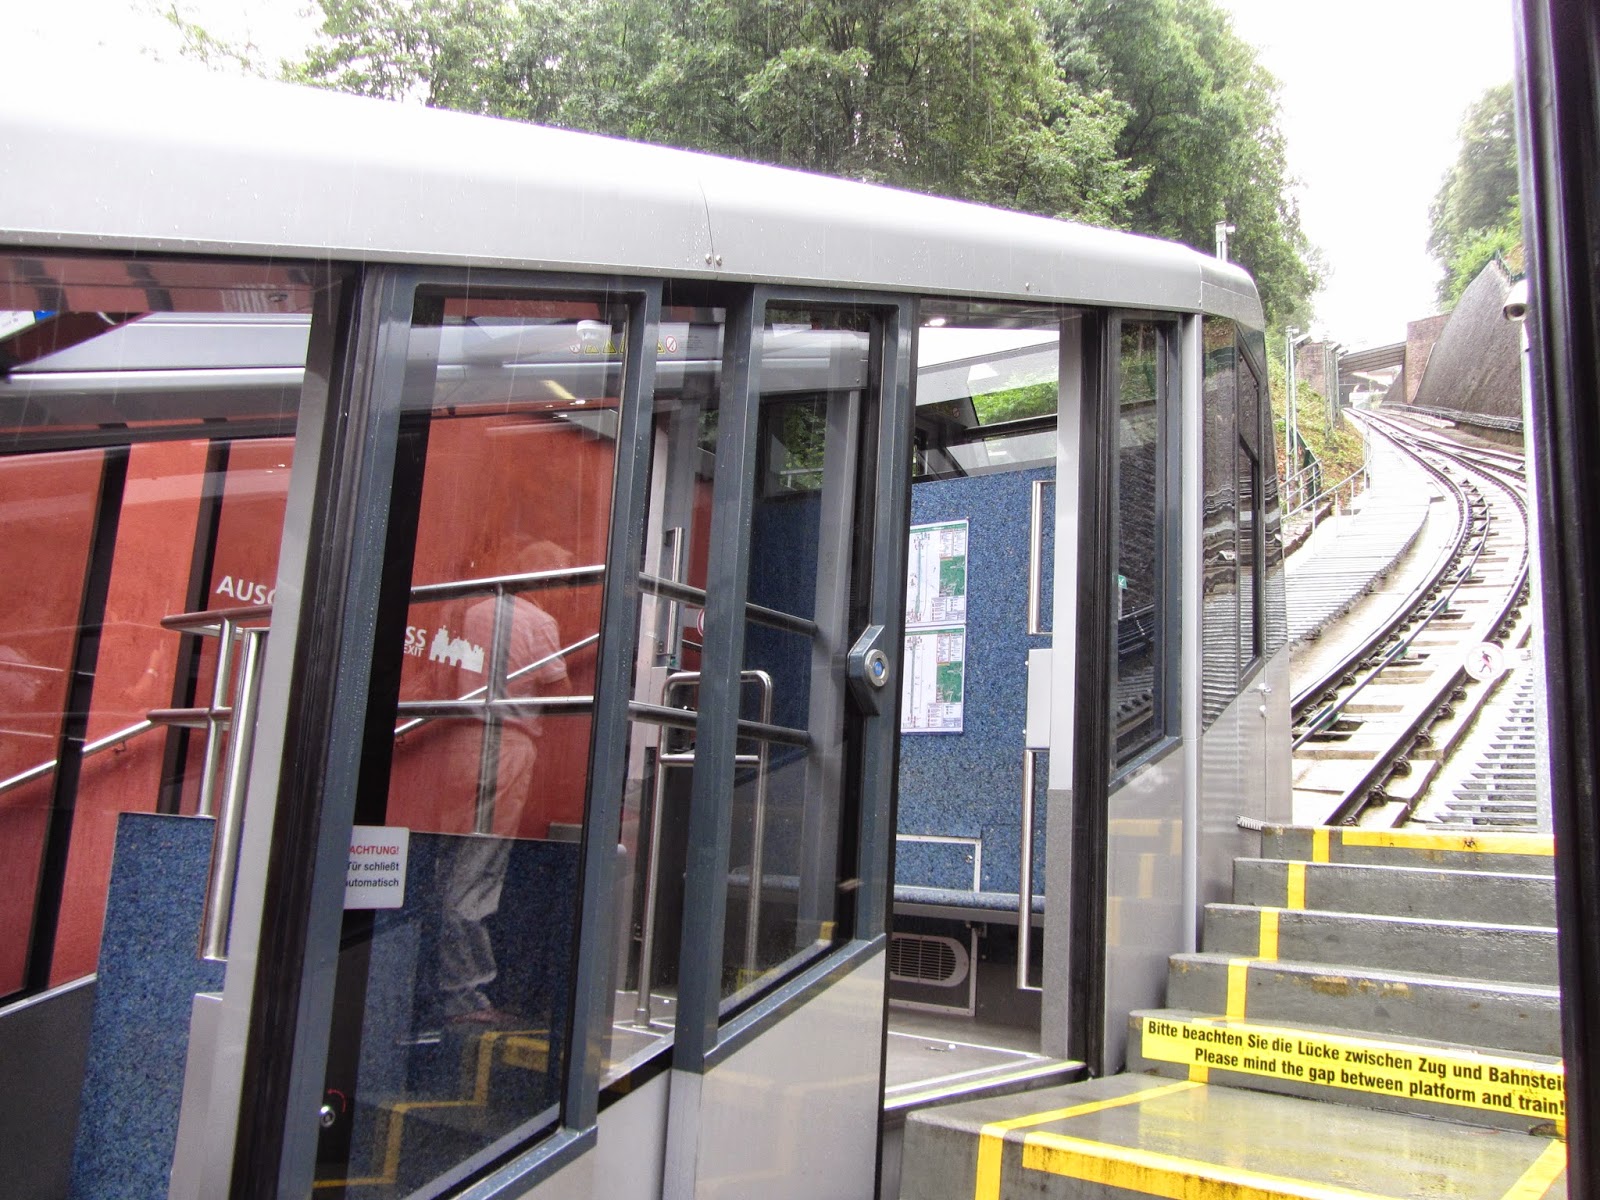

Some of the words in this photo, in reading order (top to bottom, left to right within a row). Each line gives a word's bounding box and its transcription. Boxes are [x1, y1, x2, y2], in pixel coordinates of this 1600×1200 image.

[404, 643, 424, 657] EXIT
[350, 845, 399, 855] ACHTUNG!
[363, 861, 399, 871] schließt
[1148, 1020, 1178, 1037] Bitte
[1182, 1025, 1243, 1047] beachten
[1247, 1034, 1268, 1050] Sie
[1272, 1038, 1292, 1053] die
[1298, 1040, 1339, 1060] Lücke
[1345, 1050, 1412, 1070] zwischen
[1418, 1057, 1446, 1079] Zug
[1453, 1064, 1482, 1080] und
[1488, 1066, 1566, 1092] Bahnstei
[1195, 1048, 1238, 1066] Please
[1243, 1056, 1276, 1072] mind
[1281, 1060, 1304, 1077] the
[1309, 1067, 1335, 1084] gap
[1341, 1069, 1403, 1092] between
[1409, 1080, 1476, 1103] platform
[1482, 1092, 1512, 1108] and
[1518, 1095, 1565, 1116] train!
